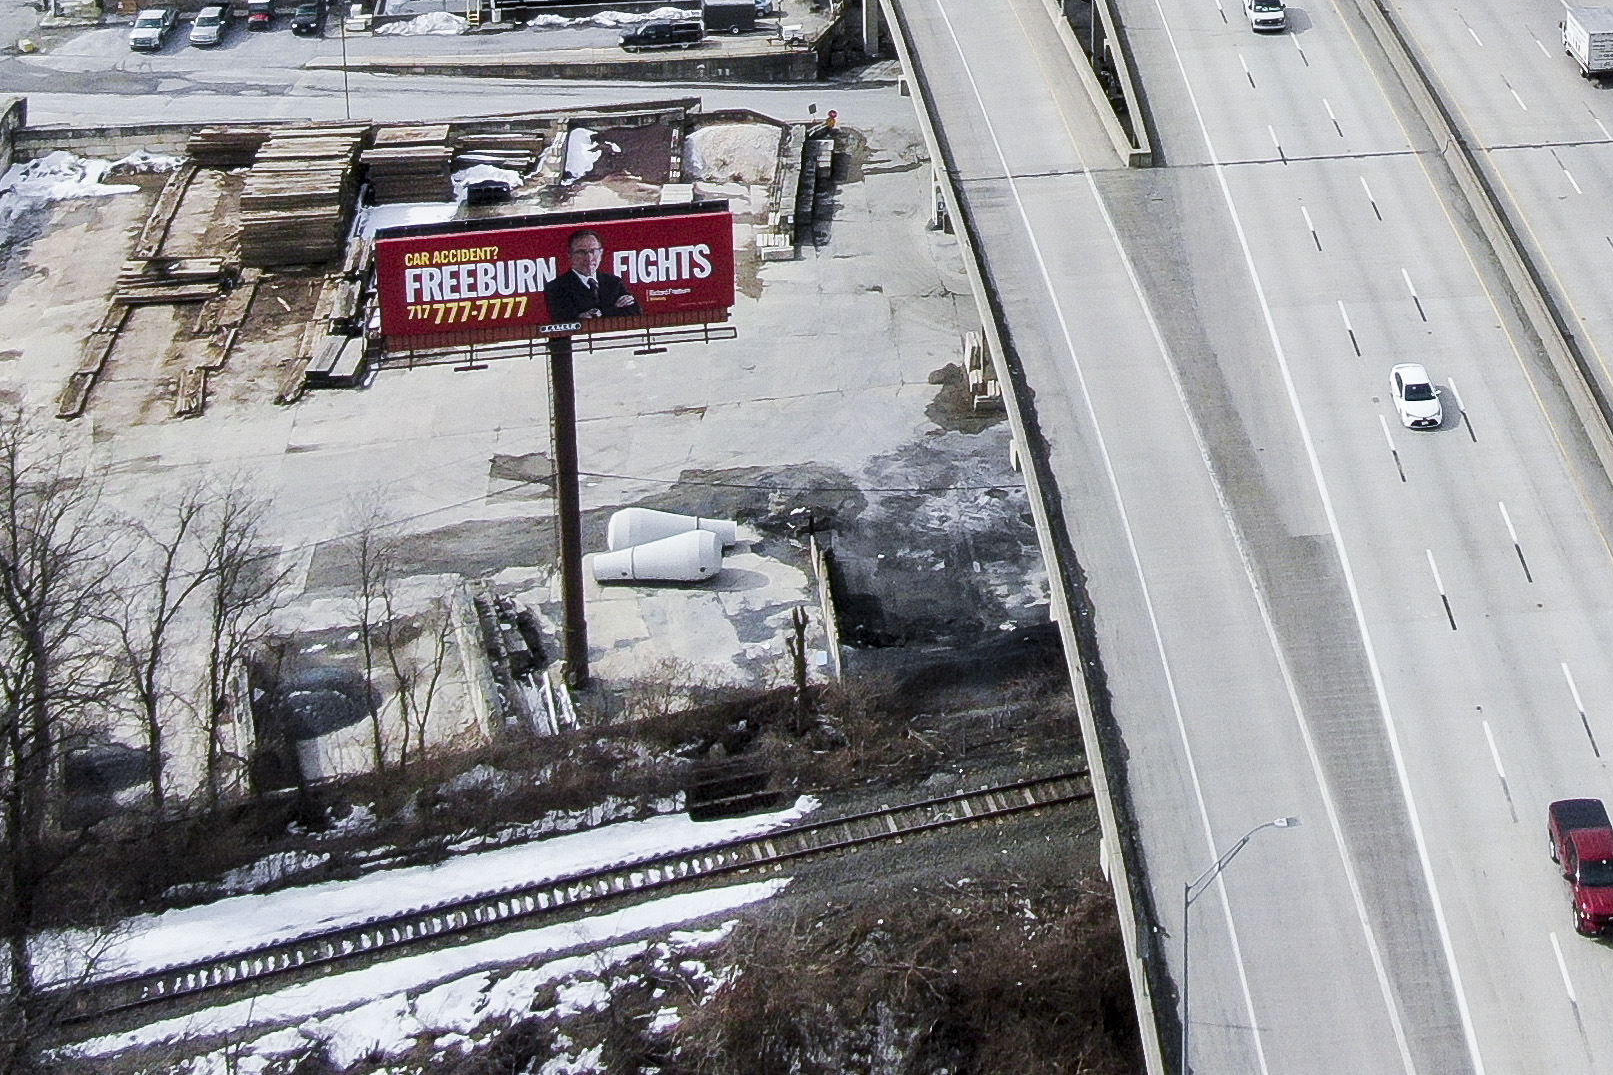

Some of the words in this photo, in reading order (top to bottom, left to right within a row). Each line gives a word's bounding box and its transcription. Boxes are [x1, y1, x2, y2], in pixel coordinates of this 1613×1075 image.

[404, 251, 430, 267] CAR
[432, 245, 499, 265] ACCIDENT?
[404, 256, 557, 303] FREEBURN
[613, 243, 712, 284] FIGHTS
[406, 304, 431, 320] 717
